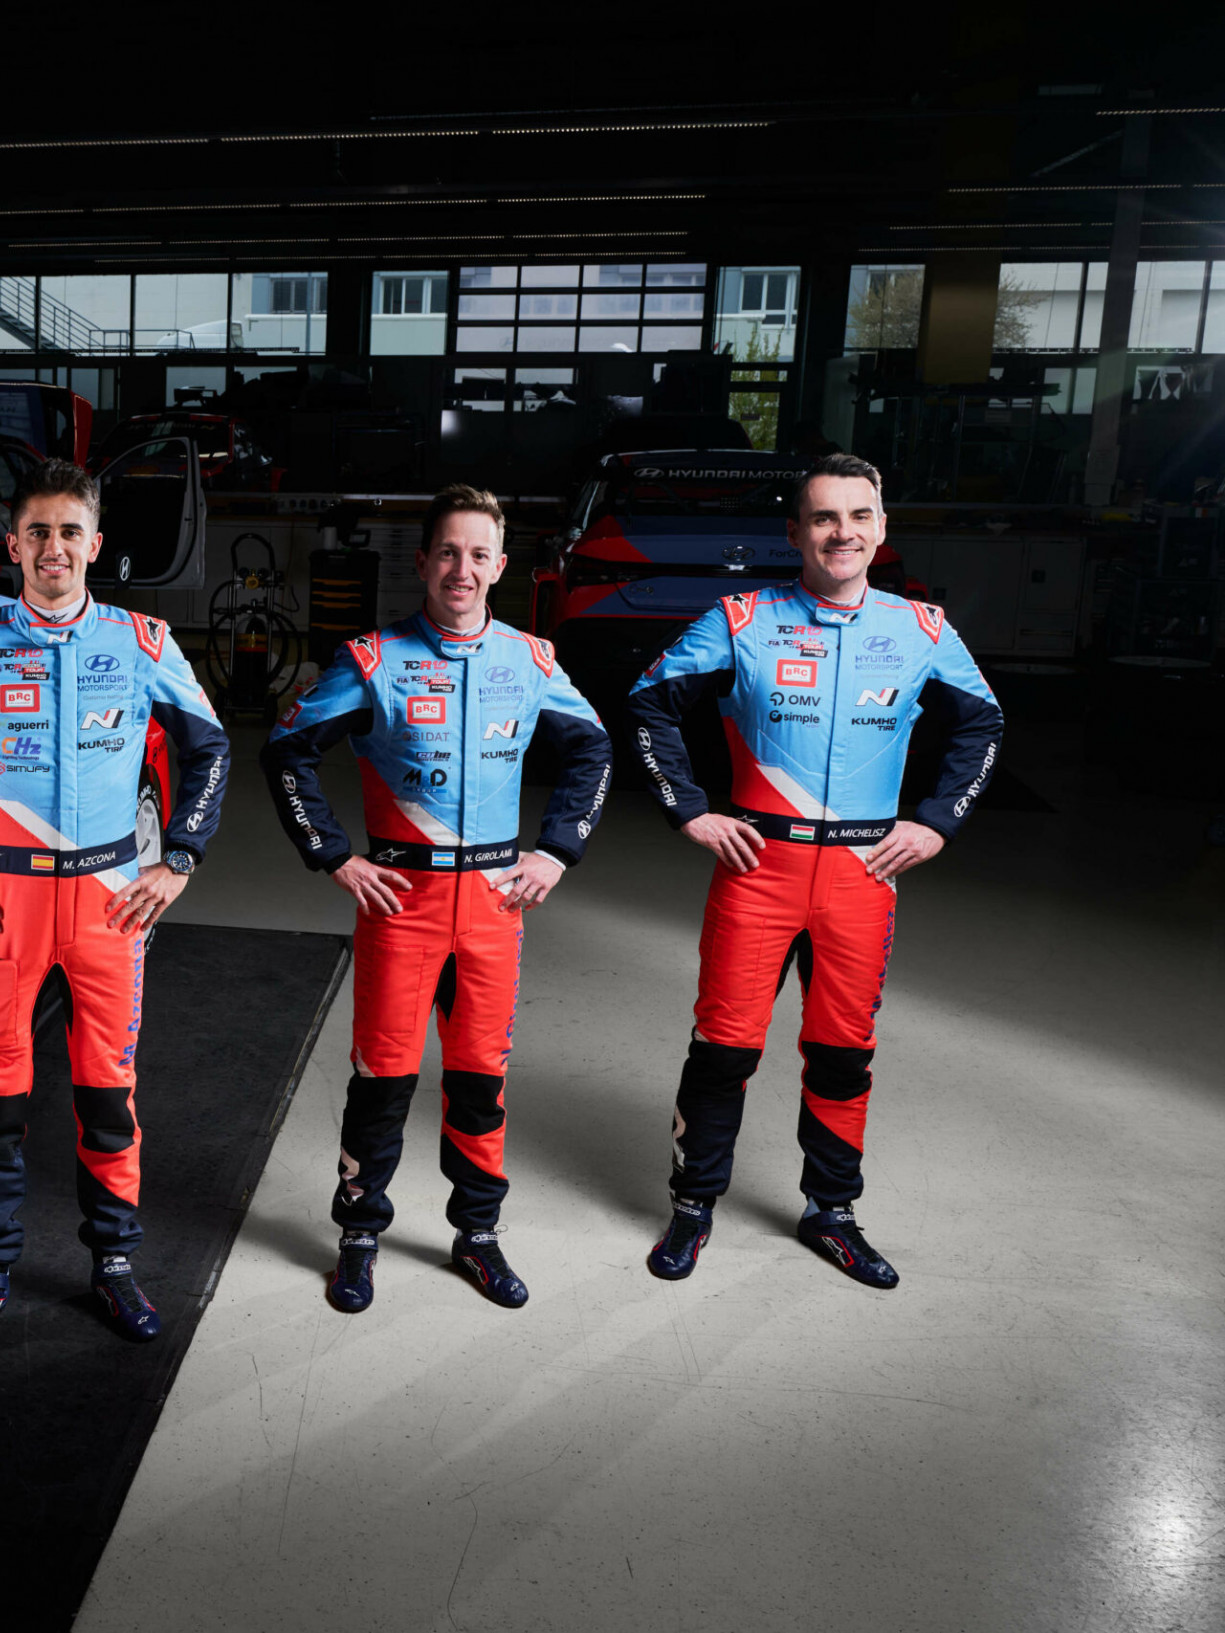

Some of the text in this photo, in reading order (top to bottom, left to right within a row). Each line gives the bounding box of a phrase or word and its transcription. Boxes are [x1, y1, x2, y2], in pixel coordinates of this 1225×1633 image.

[668, 469, 746, 479] HYUNDAI
[855, 655, 904, 664] HYUNDAI
[785, 667, 808, 677] BRC
[77, 674, 128, 684] HYUNDAI
[479, 685, 523, 696] HYUNDAI
[8, 692, 31, 702] BRC
[788, 694, 822, 707] OMV
[415, 704, 438, 713] BRC
[784, 711, 821, 725] simple
[851, 717, 897, 725] KUMHO
[8, 719, 49, 732] aguerri
[78, 737, 125, 750] KUMHO
[481, 748, 519, 759] KUMHO
[967, 742, 997, 798] HYUNDAI
[197, 755, 223, 809] HYUNDAI
[643, 753, 677, 807] HYUNDAI
[289, 796, 323, 850] HYUNDAI
[827, 827, 886, 839] N. MICHELISZ
[62, 851, 116, 870] M. AZCONA
[464, 848, 513, 864] N. GIROLAMI
